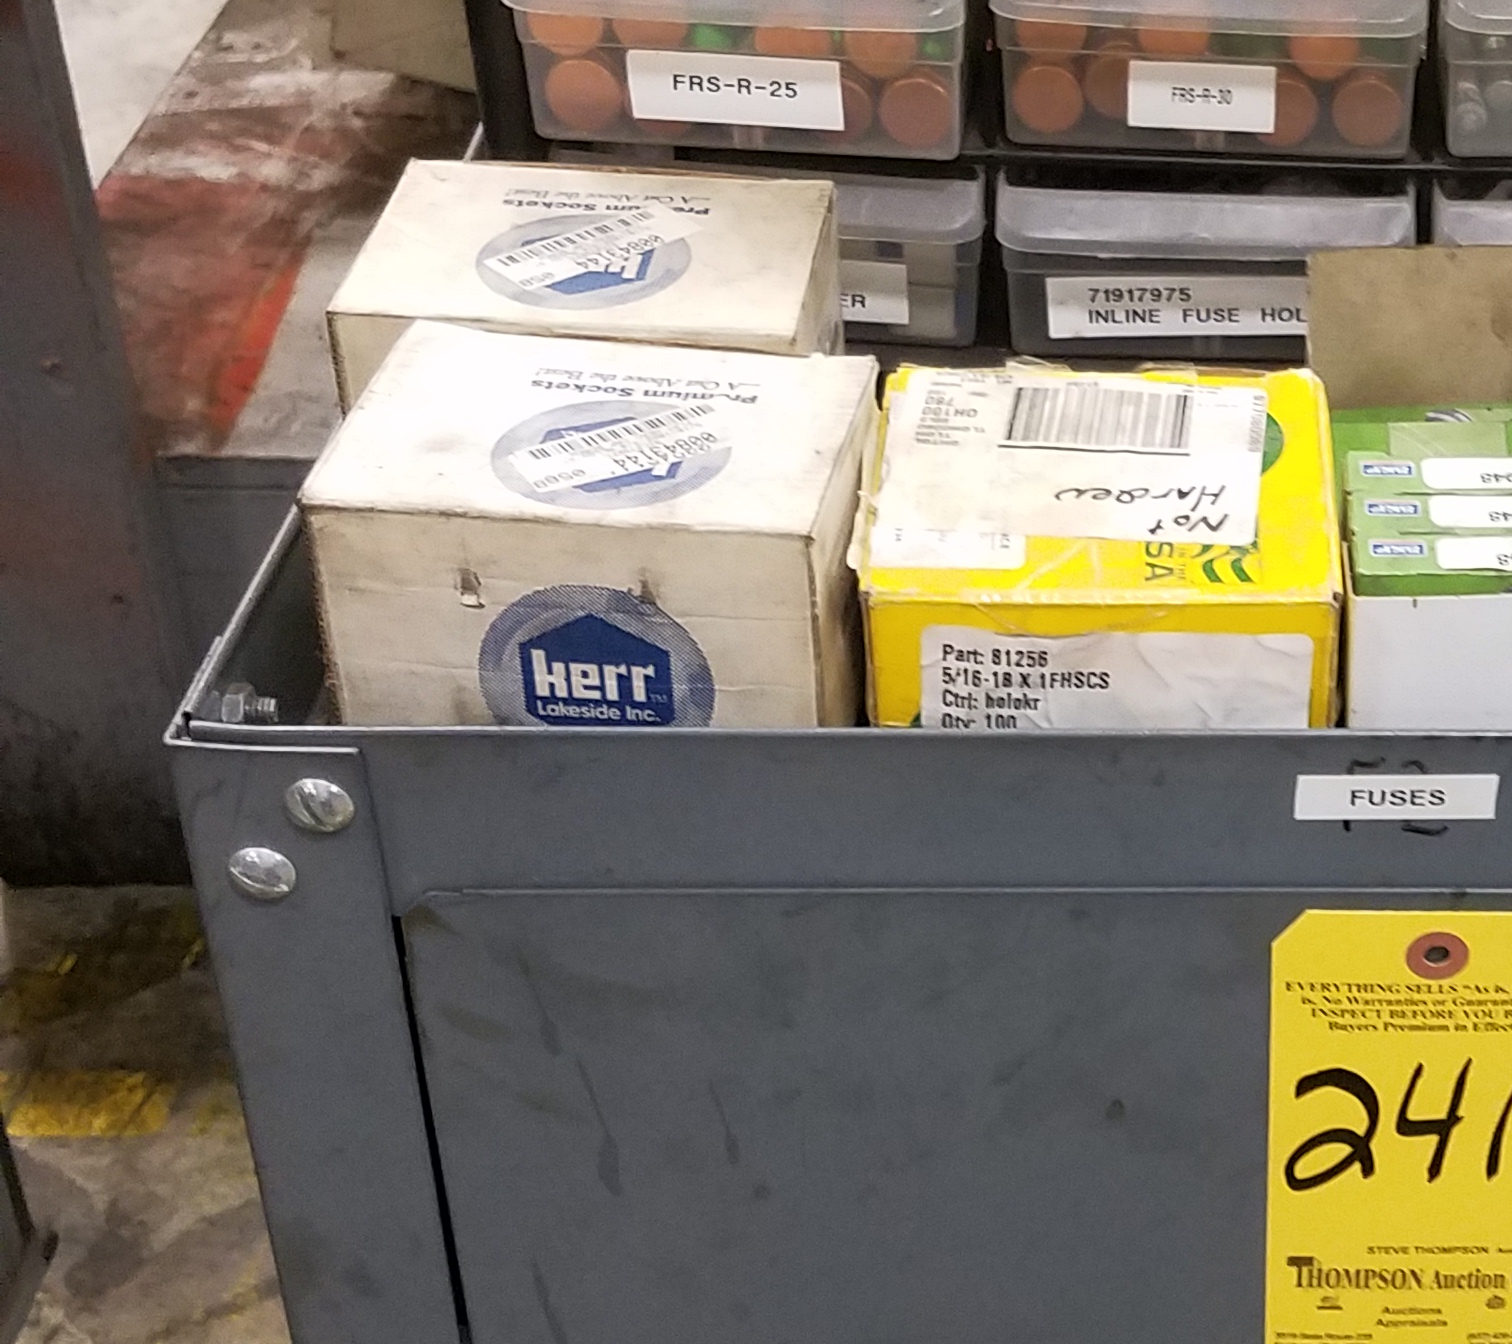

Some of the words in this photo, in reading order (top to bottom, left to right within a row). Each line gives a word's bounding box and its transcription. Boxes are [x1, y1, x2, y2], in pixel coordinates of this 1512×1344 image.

[673, 74, 797, 98] FRS-R-25
[1172, 85, 1232, 104] FRS-R-30
[503, 199, 596, 211] Sockets
[606, 204, 710, 216] Preum
[1088, 287, 1192, 303] 71917975
[1088, 307, 1161, 324] INLINE
[1182, 308, 1241, 323] FUSE
[531, 380, 635, 397] Sockets
[643, 389, 758, 404] Prmium
[1145, 541, 1174, 582] SA
[942, 644, 984, 665] Part:
[992, 649, 1048, 668] 81256
[530, 649, 655, 702] kerr
[942, 667, 1013, 690] 5/16-18
[1018, 673, 1031, 689] X
[1039, 671, 1110, 689] 1FHSCS
[537, 701, 620, 722] Lakeside
[626, 704, 661, 723] Inc.
[1350, 790, 1446, 807] FUSES
[1286, 981, 1400, 994] EVERYTHING
[1405, 983, 1458, 994] SELLS
[1346, 996, 1428, 1007] Warranties
[1311, 1008, 1383, 1019] INSPECT
[1389, 1008, 1454, 1020] BEFORE
[1463, 1009, 1497, 1020] YOU
[1329, 1021, 1378, 1033] Buyers
[1384, 1021, 1450, 1033] Premium
[1287, 1256, 1424, 1290] THOMPSON
[1430, 1268, 1506, 1290] Auction
